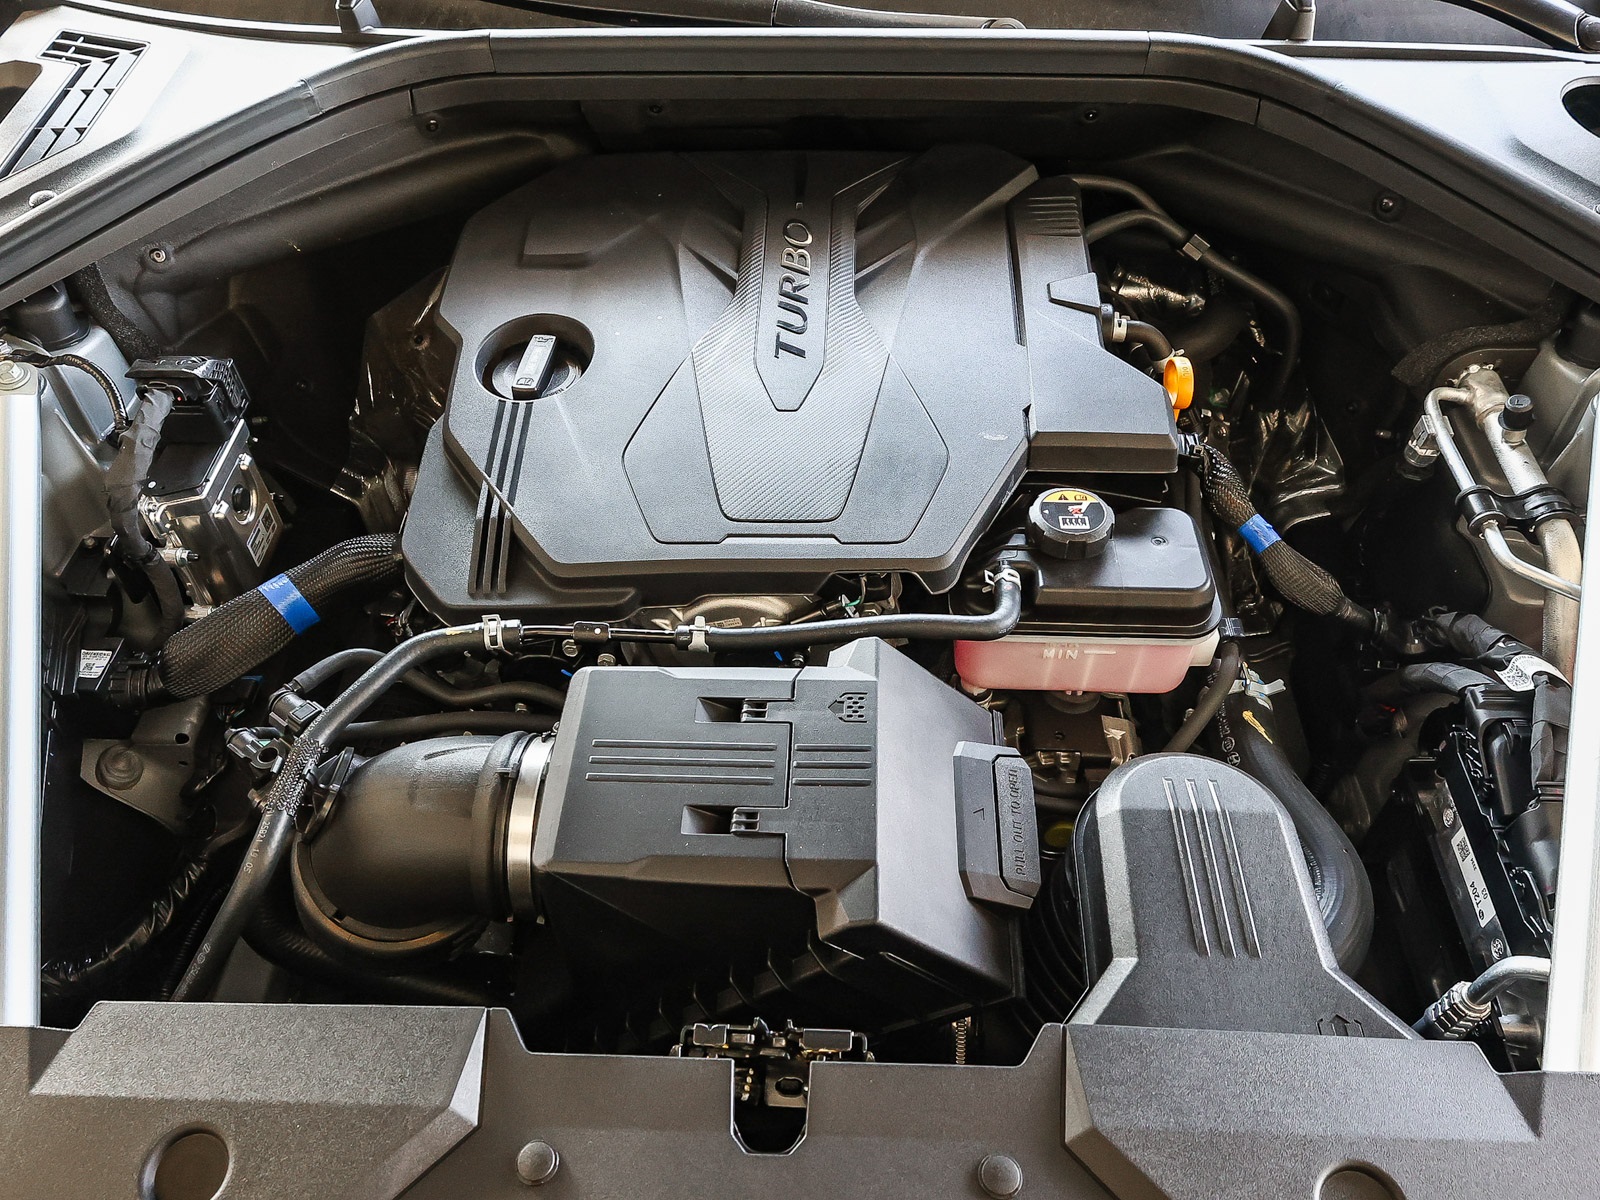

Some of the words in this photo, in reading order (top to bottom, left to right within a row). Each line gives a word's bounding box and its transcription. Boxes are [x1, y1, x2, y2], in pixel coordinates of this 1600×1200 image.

[774, 219, 812, 359] TURBO
[1042, 648, 1078, 660] MIN
[1009, 769, 1020, 798] OPEN
[1011, 801, 1021, 814] TO
[1013, 820, 1024, 843] OUT
[1014, 849, 1026, 875] PULL
[1469, 881, 1481, 908] T204
[1481, 887, 1488, 900] 03
